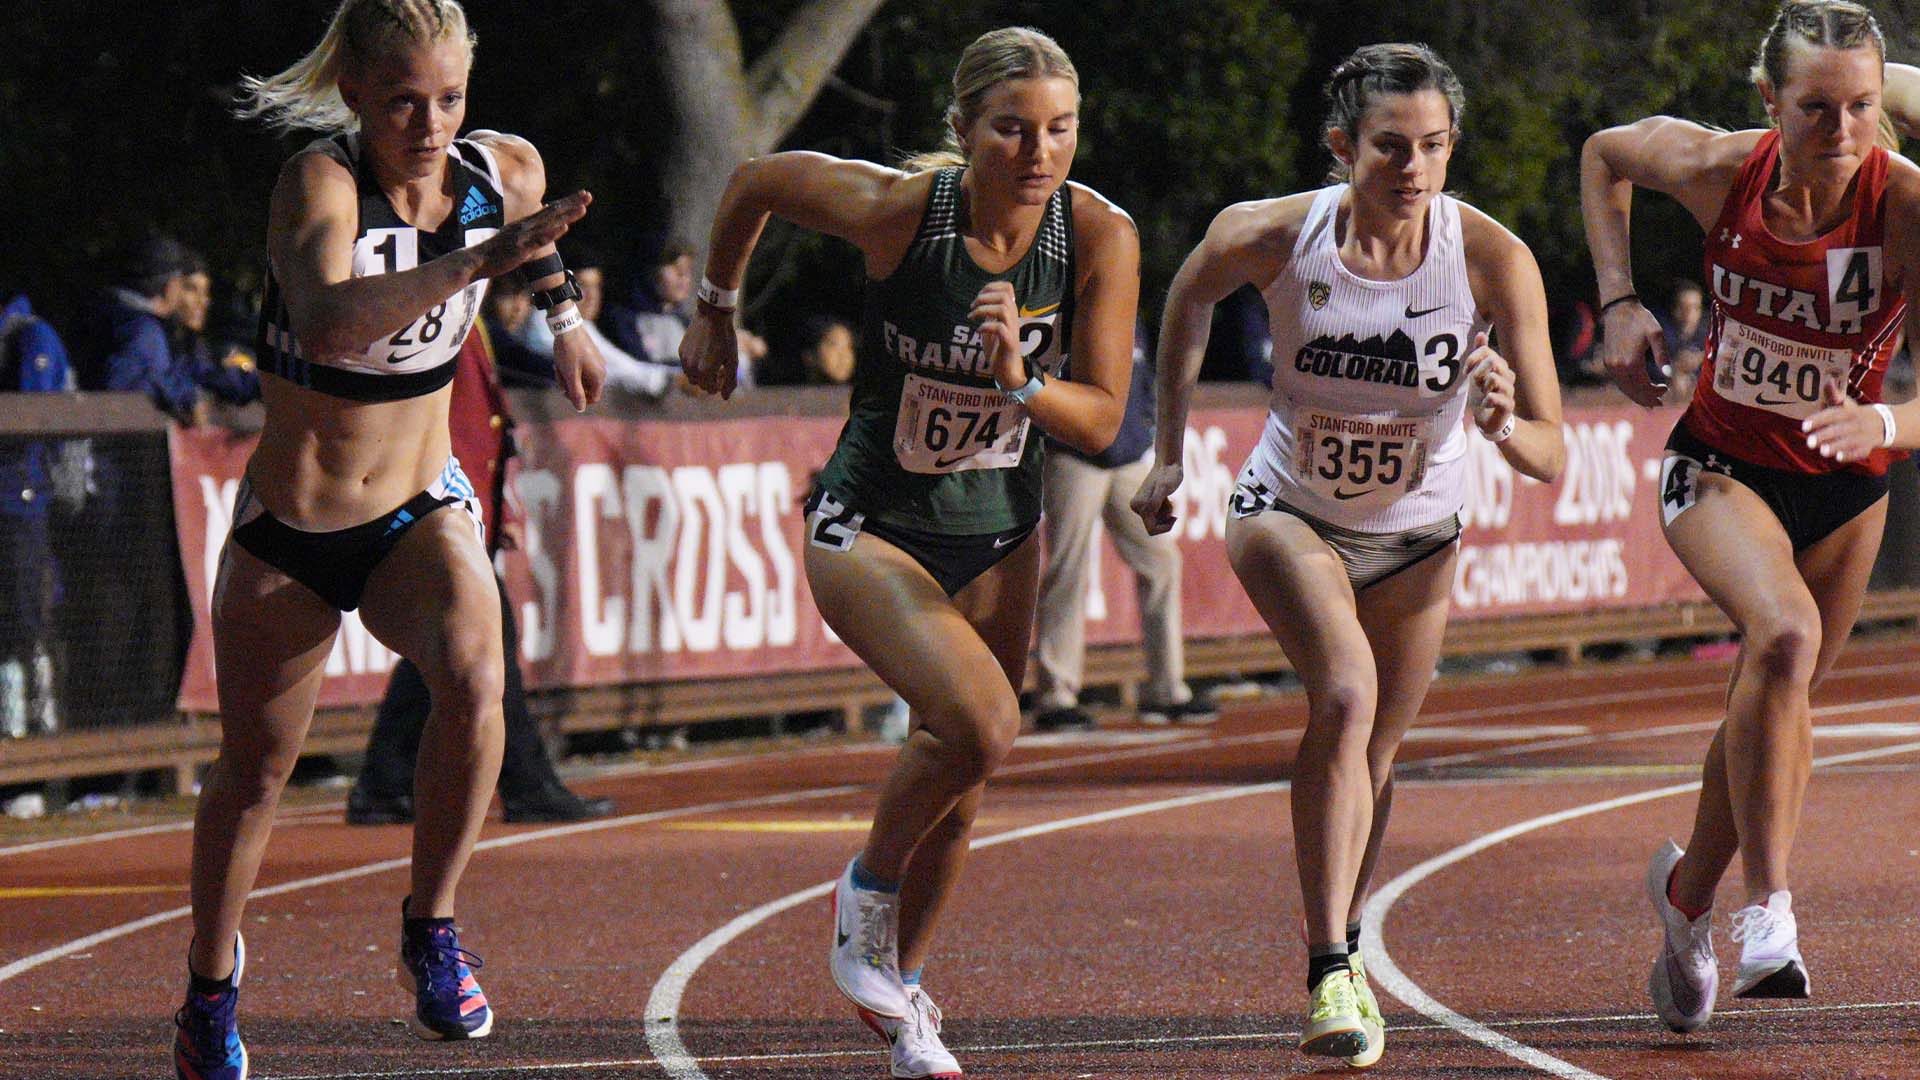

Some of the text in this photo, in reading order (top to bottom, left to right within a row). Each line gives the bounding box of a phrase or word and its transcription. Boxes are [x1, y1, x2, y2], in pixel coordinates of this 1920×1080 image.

[459, 203, 498, 225] adidas
[373, 233, 397, 275] 1
[1836, 251, 1875, 312] 4
[1424, 332, 1460, 392] 3
[1738, 324, 1835, 363] STANFORD INVITE
[1294, 346, 1419, 388] COLORAD
[1741, 347, 1821, 402] 940
[917, 383, 980, 408] STANFORD
[924, 407, 1002, 452] 674
[1310, 414, 1417, 437] STANFORD INVITE
[1318, 436, 1404, 485] 355
[1663, 459, 1691, 509] 4
[574, 460, 797, 656] CROSS
